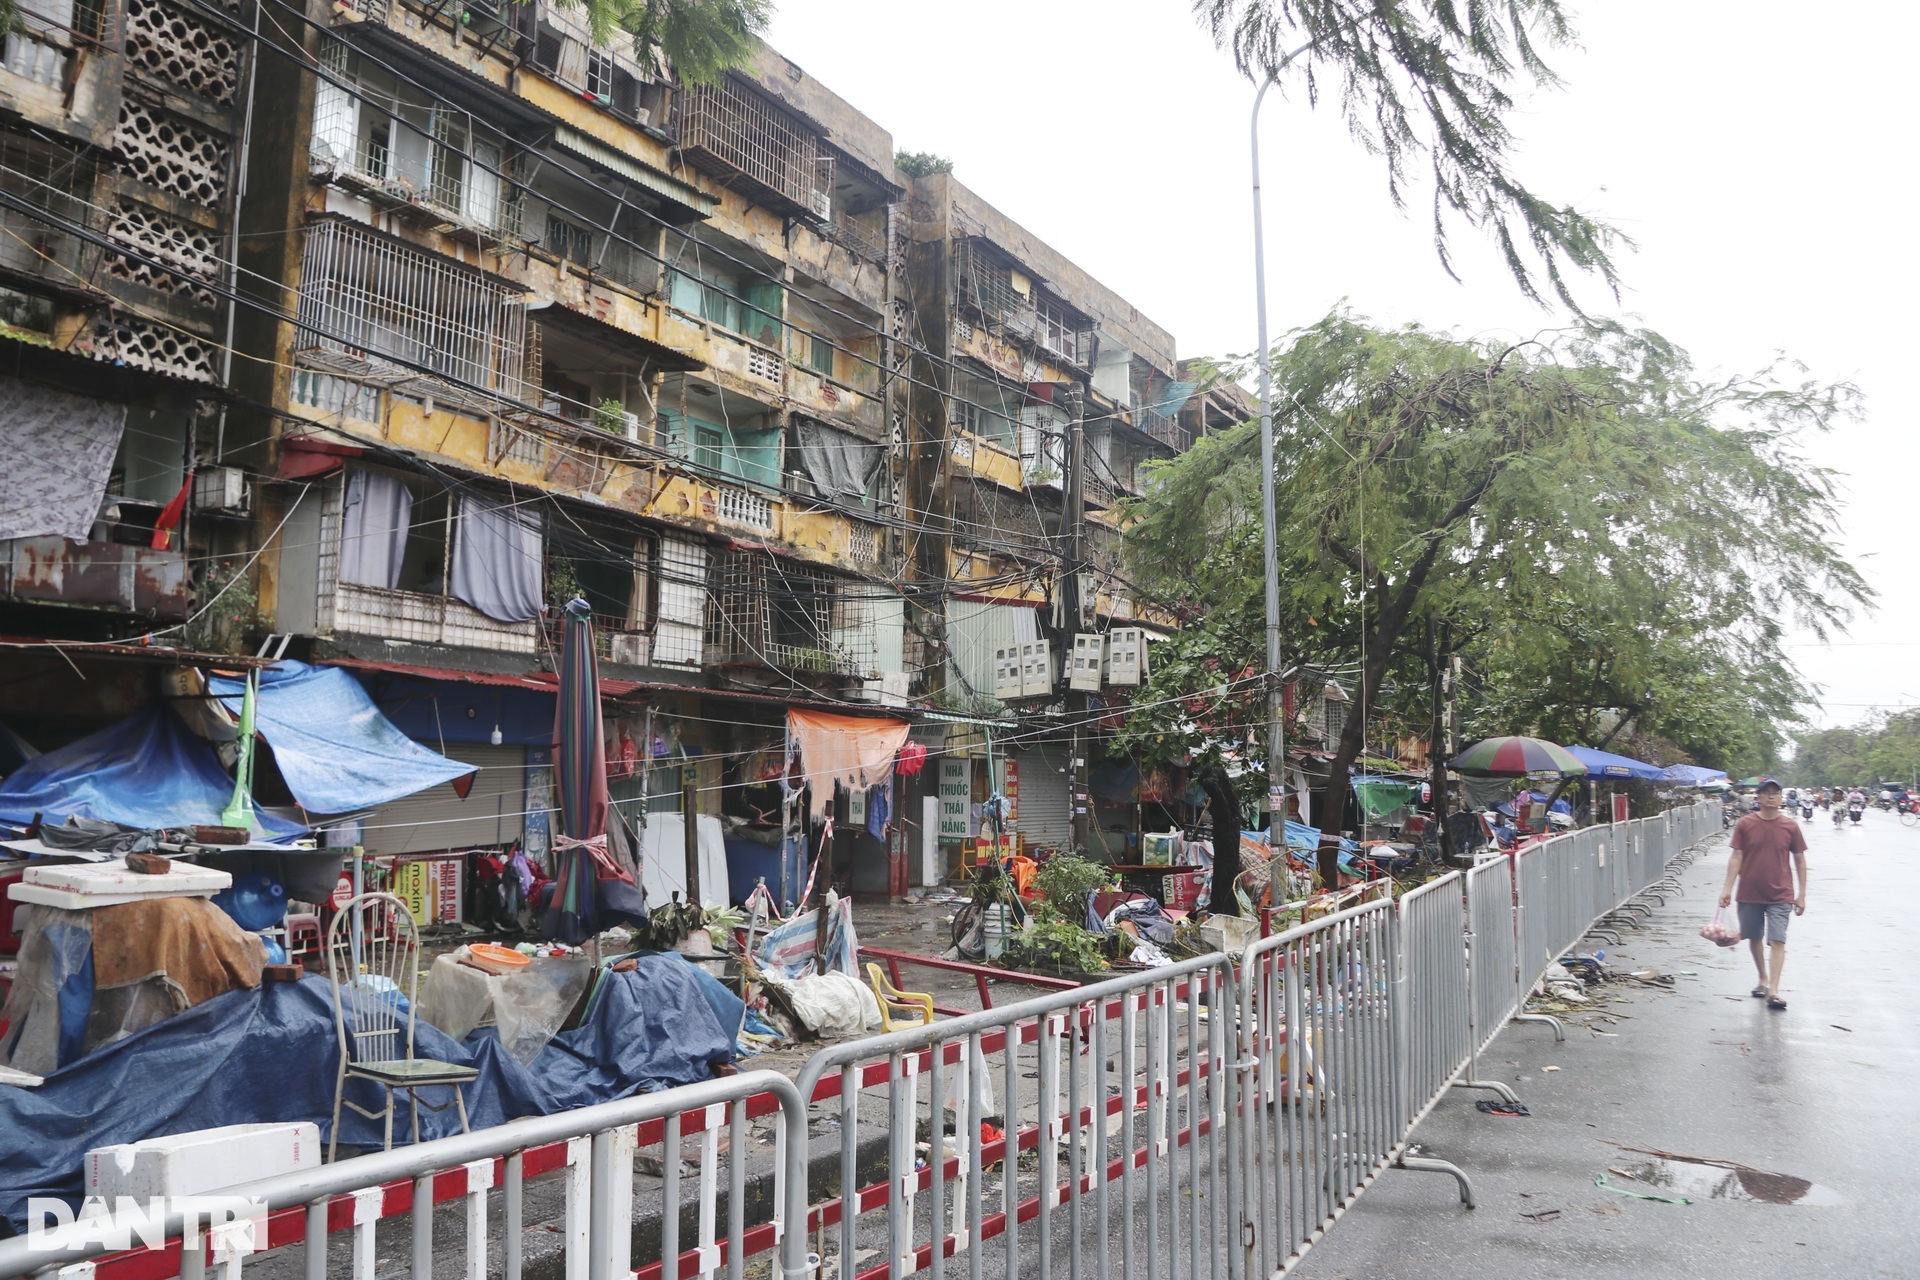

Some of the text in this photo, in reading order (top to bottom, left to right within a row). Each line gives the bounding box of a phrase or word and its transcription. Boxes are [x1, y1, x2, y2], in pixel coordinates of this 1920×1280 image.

[945, 763, 963, 777] NHÀ
[940, 780, 968, 795] THUỐC
[944, 799, 963, 814] THÁI
[412, 864, 422, 914] maxim
